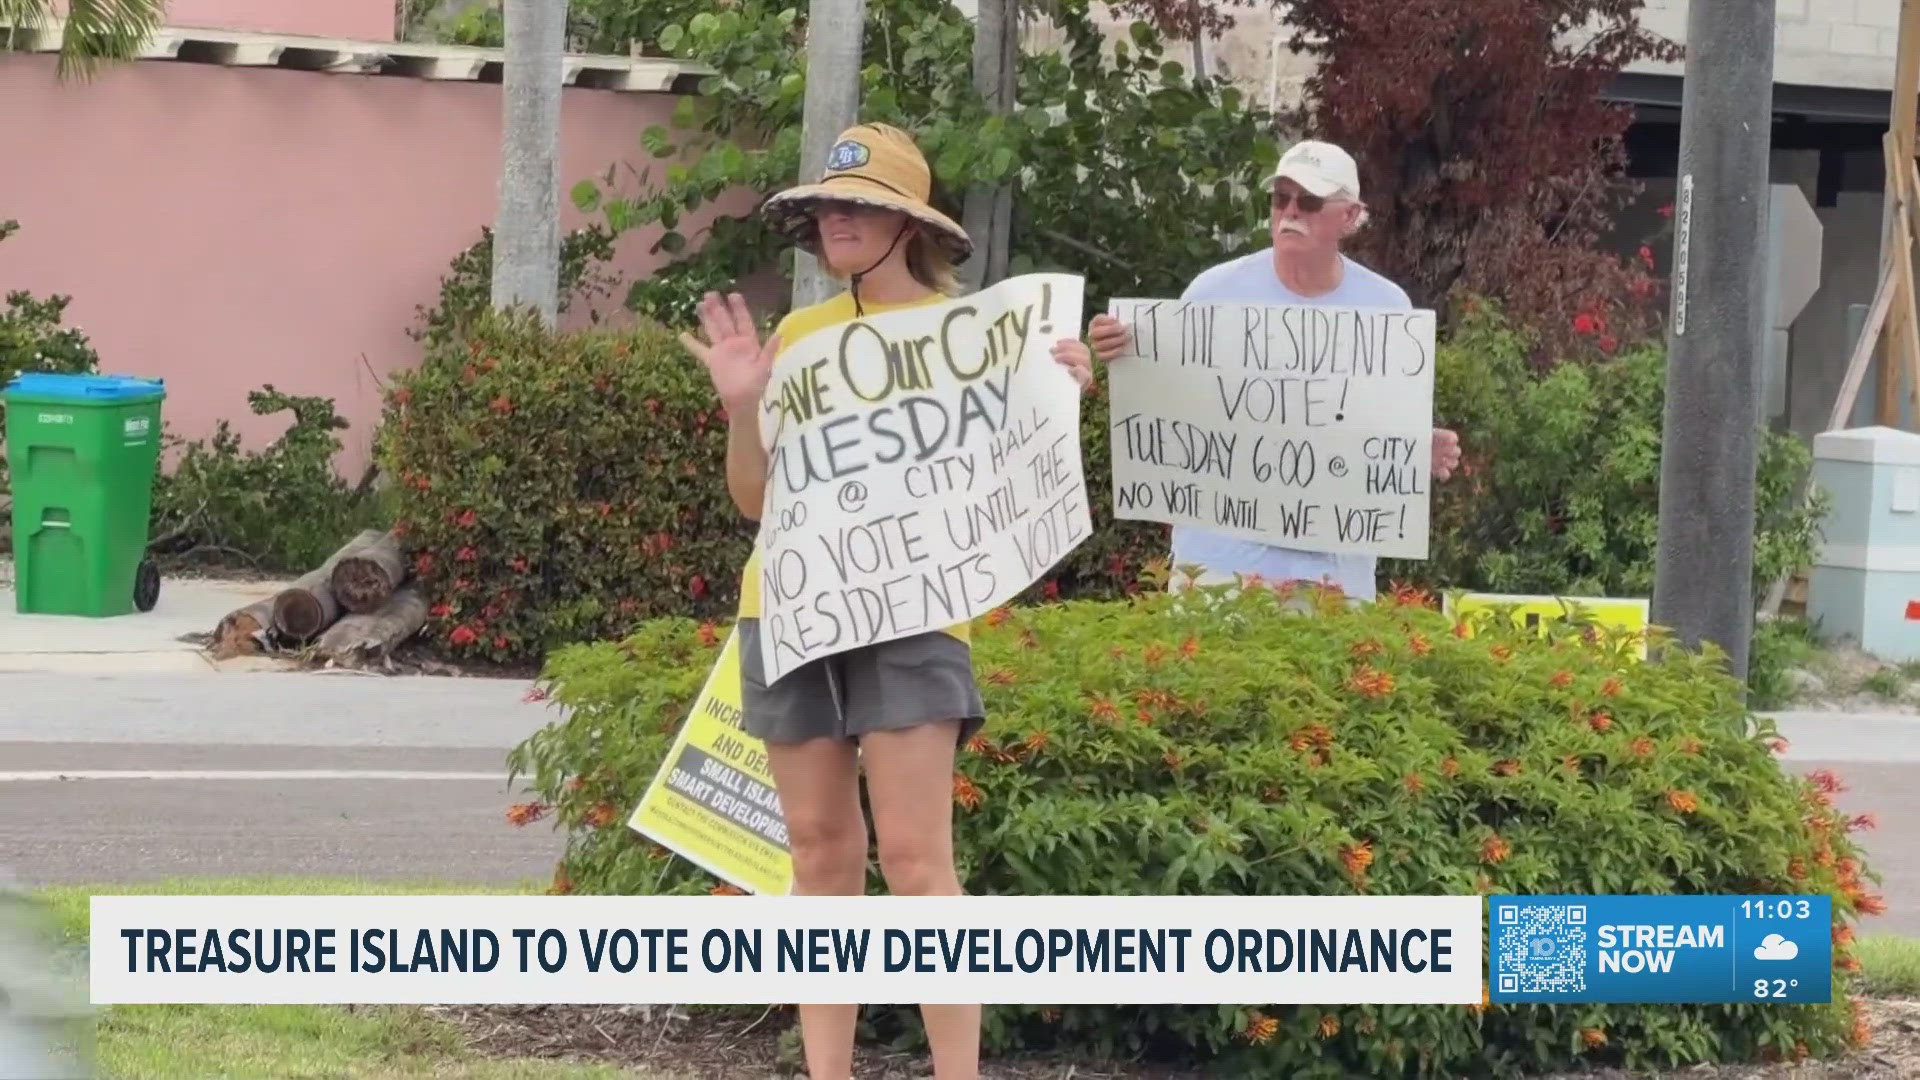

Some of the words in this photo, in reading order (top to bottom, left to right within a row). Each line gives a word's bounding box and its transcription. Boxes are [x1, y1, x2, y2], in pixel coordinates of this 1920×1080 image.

[1173, 301, 1223, 368] THE
[1243, 305, 1425, 377] RESIDENTS
[1217, 375, 1348, 427] VOTE!
[838, 481, 868, 513] @
[905, 453, 974, 498] CITY
[989, 407, 1049, 474] HALL
[1113, 413, 1236, 479] TUESDAY
[1329, 456, 1348, 477] @
[1364, 437, 1416, 464] CITY
[1367, 465, 1424, 494] HALL
[764, 549, 807, 616] NO
[818, 511, 929, 584] VOTE
[943, 477, 1030, 551] UNTIL
[1027, 433, 1071, 499] THE
[1119, 482, 1153, 509] NO
[1161, 481, 1203, 518] VOTE
[1214, 490, 1267, 532] UNTIL
[1281, 499, 1321, 539] WE
[1335, 503, 1406, 542] VOTE!
[770, 553, 996, 675] RESIDENTS
[1013, 482, 1083, 580] VOTE
[705, 696, 743, 729] INCR
[711, 732, 745, 762] AND
[667, 767, 714, 802] SMART
[699, 757, 742, 794] SMALL
[743, 779, 785, 817] ISLAN
